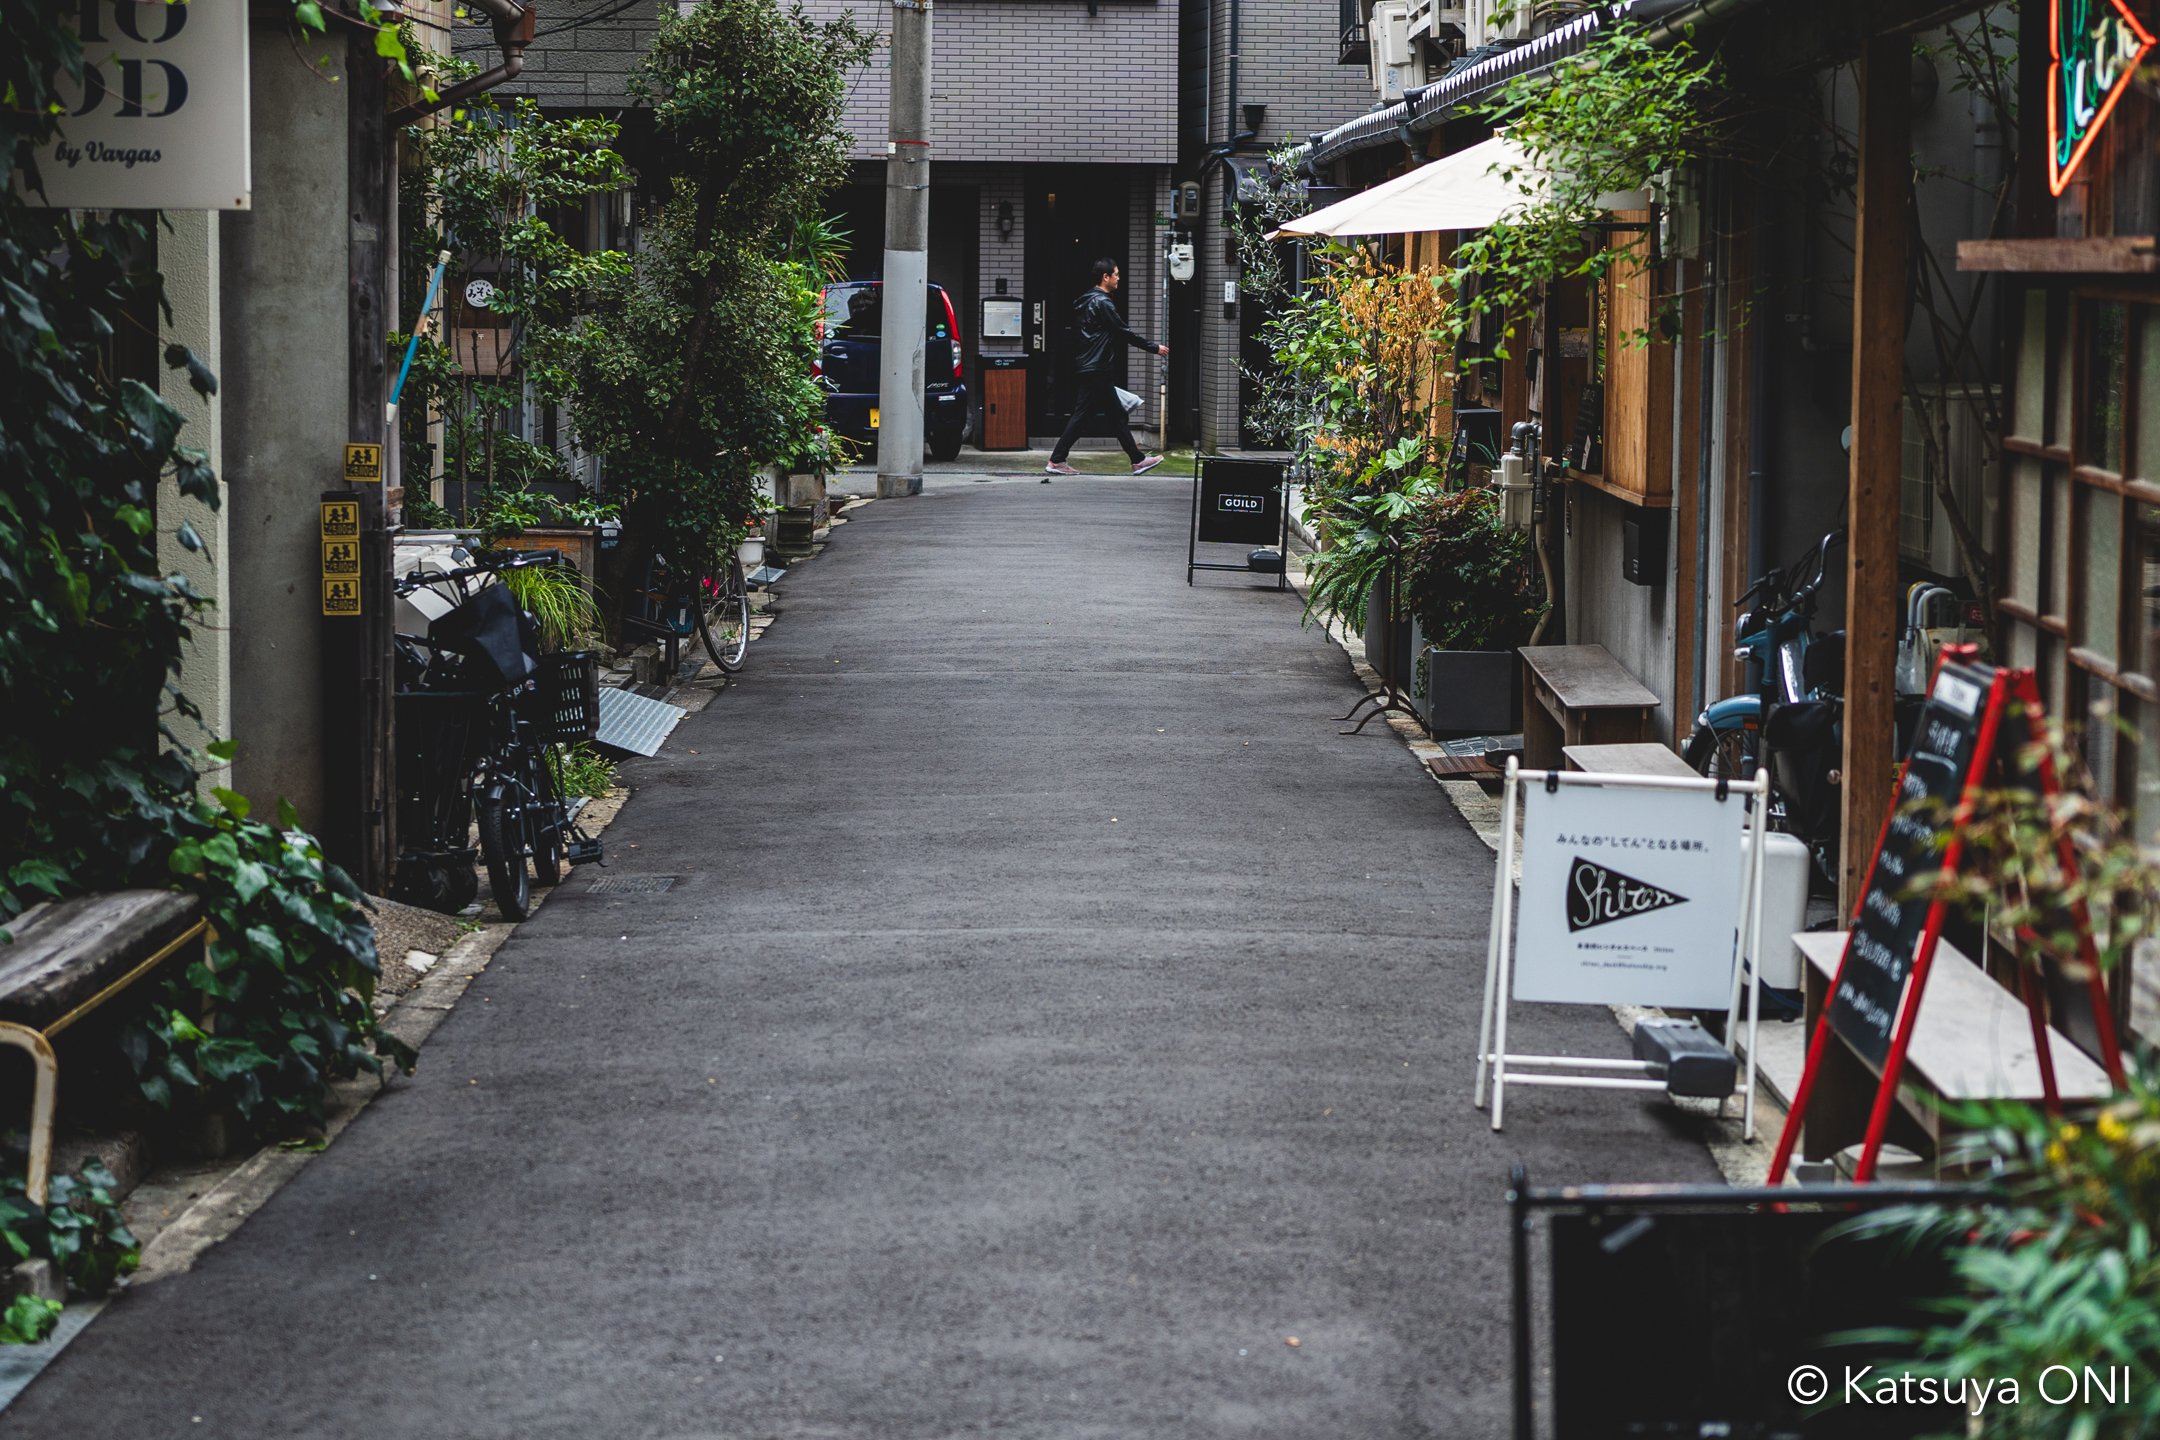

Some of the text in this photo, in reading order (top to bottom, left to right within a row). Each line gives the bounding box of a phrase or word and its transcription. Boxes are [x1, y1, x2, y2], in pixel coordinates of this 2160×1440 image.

[55, 140, 162, 169] by Vargas
[1225, 499, 1257, 508] GUILD
